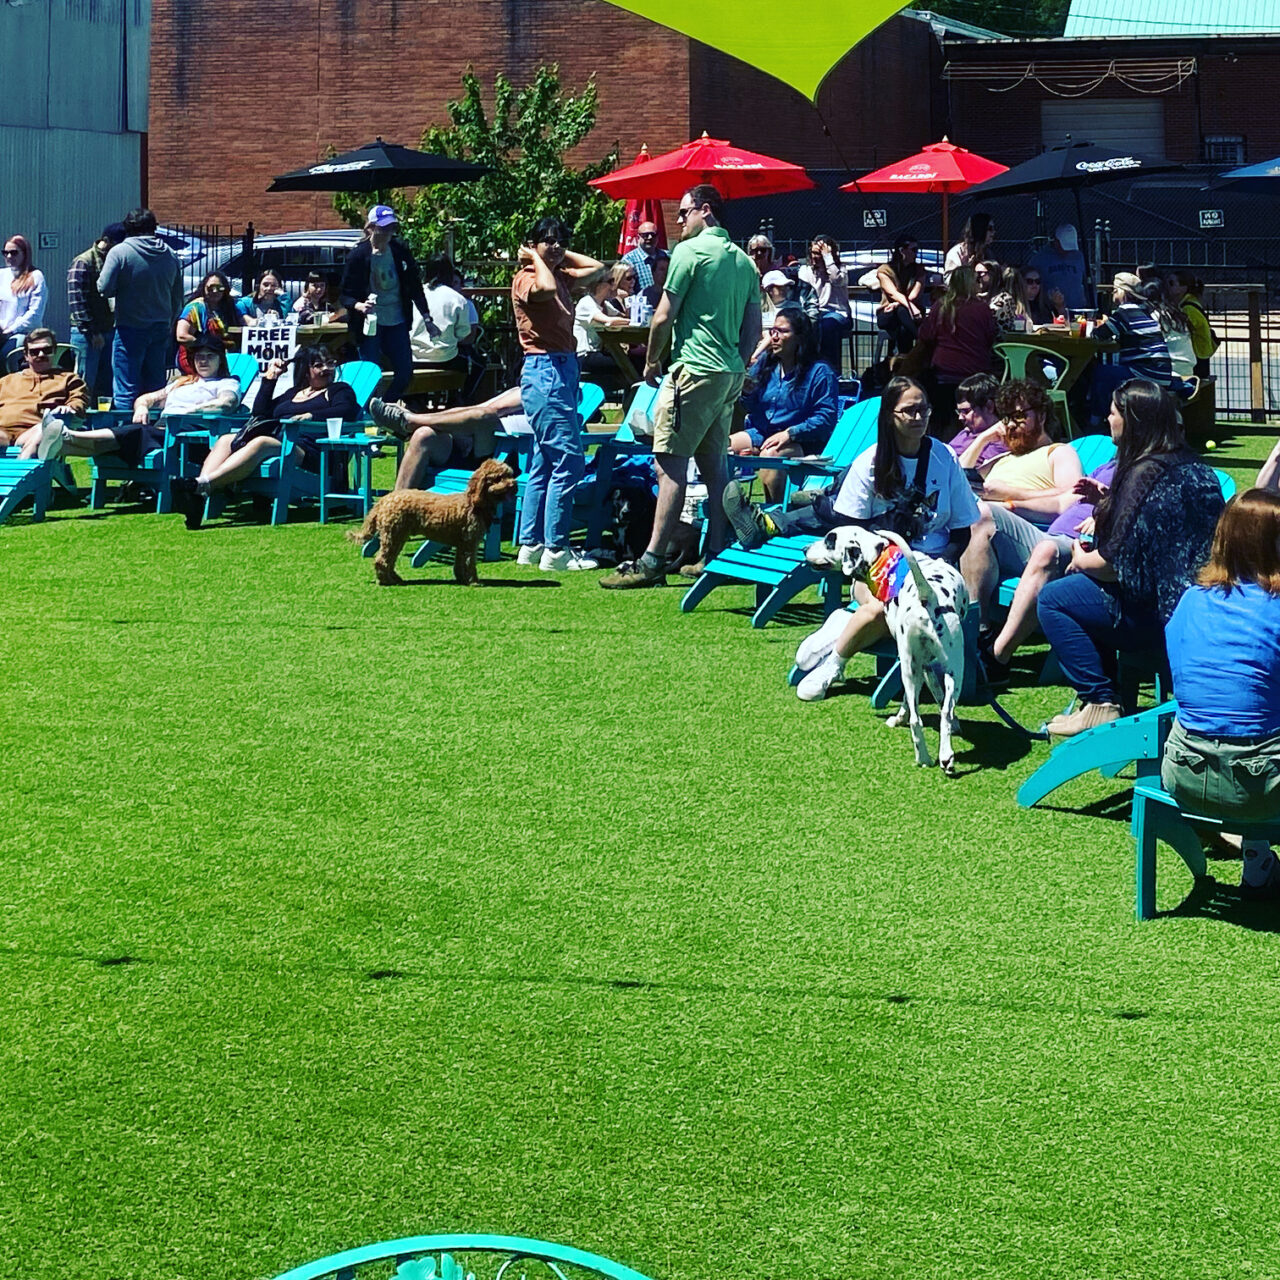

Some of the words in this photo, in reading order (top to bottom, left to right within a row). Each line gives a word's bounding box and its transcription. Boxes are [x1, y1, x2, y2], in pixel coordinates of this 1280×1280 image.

[1076, 156, 1135, 170] Coca-Cola
[248, 328, 290, 341] FREE
[247, 342, 289, 360] MOM
